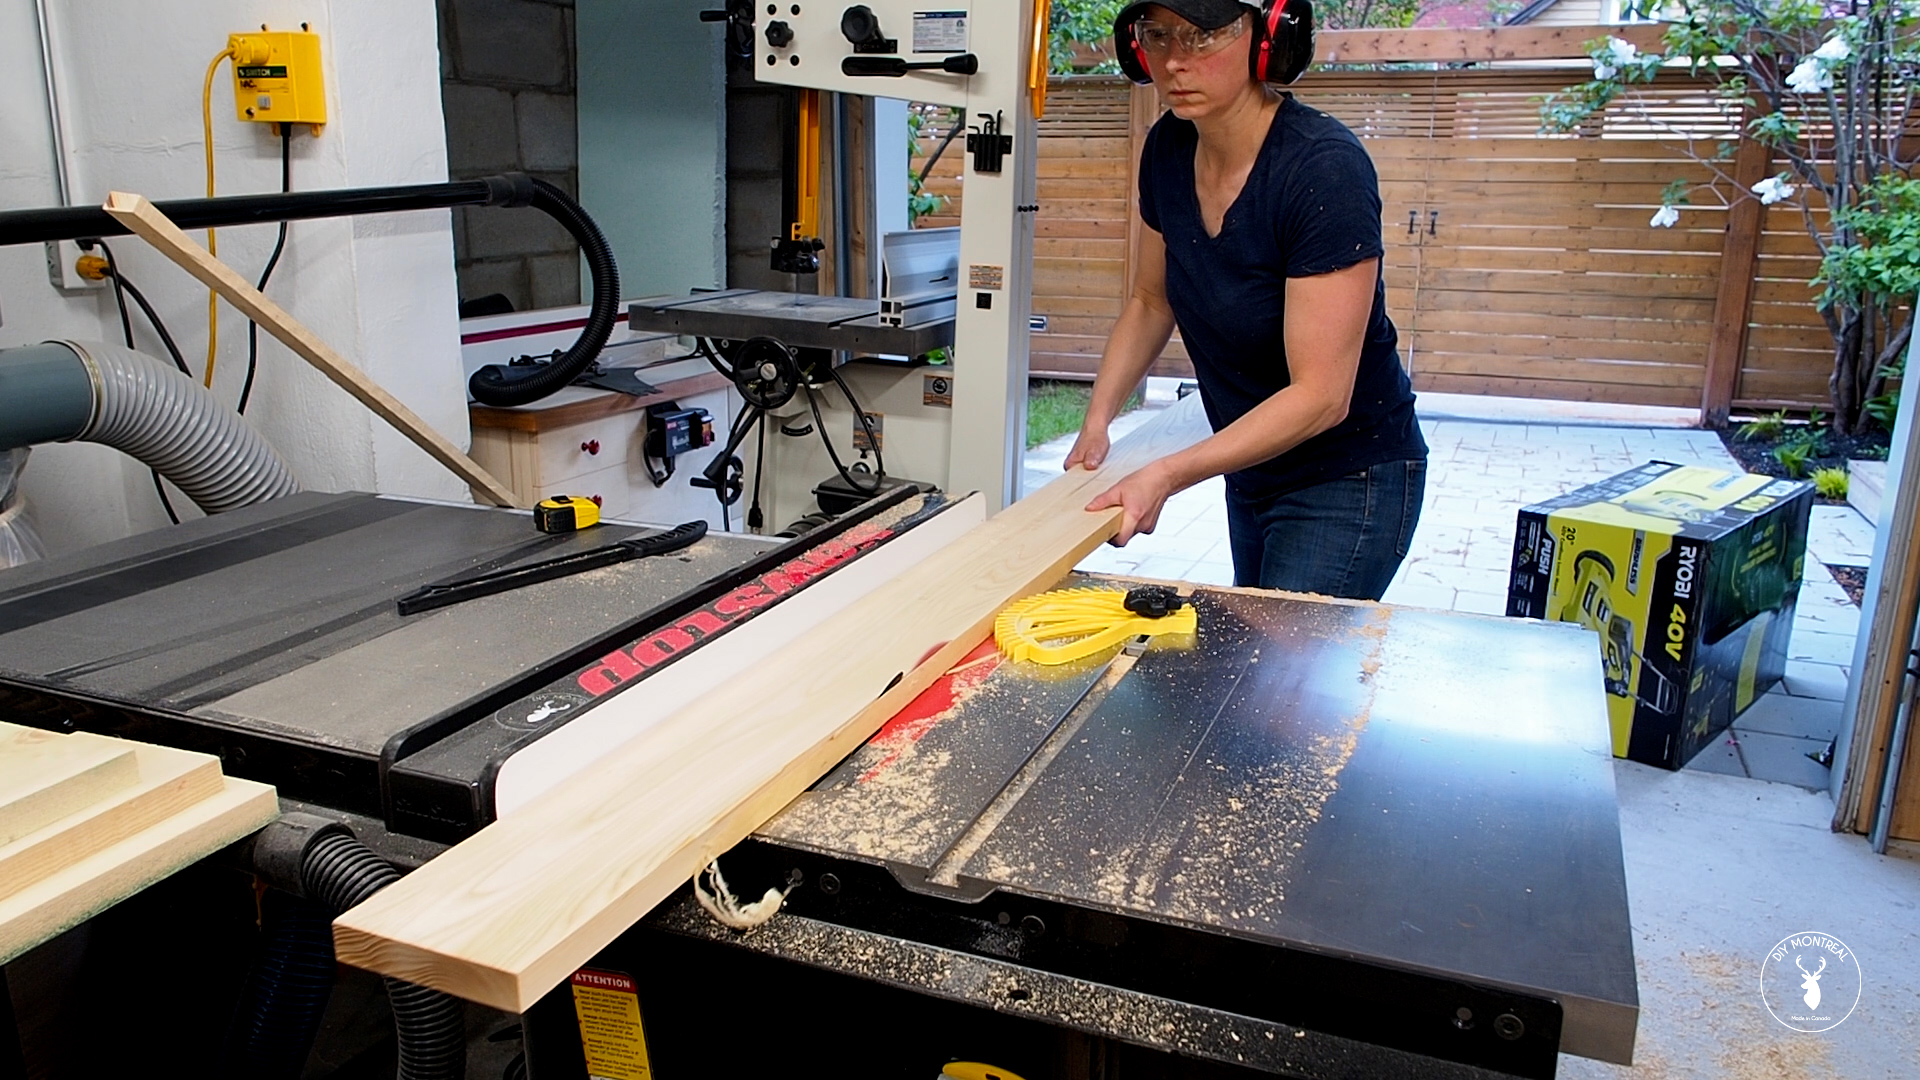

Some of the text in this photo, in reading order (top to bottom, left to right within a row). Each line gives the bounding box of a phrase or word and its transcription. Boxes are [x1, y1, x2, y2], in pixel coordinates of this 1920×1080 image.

[1538, 537, 1553, 576] PUSH
[1629, 537, 1643, 584] BRUSHLESS
[1665, 545, 1697, 662] RYOBI 40V
[575, 972, 631, 989] ATTENTION
